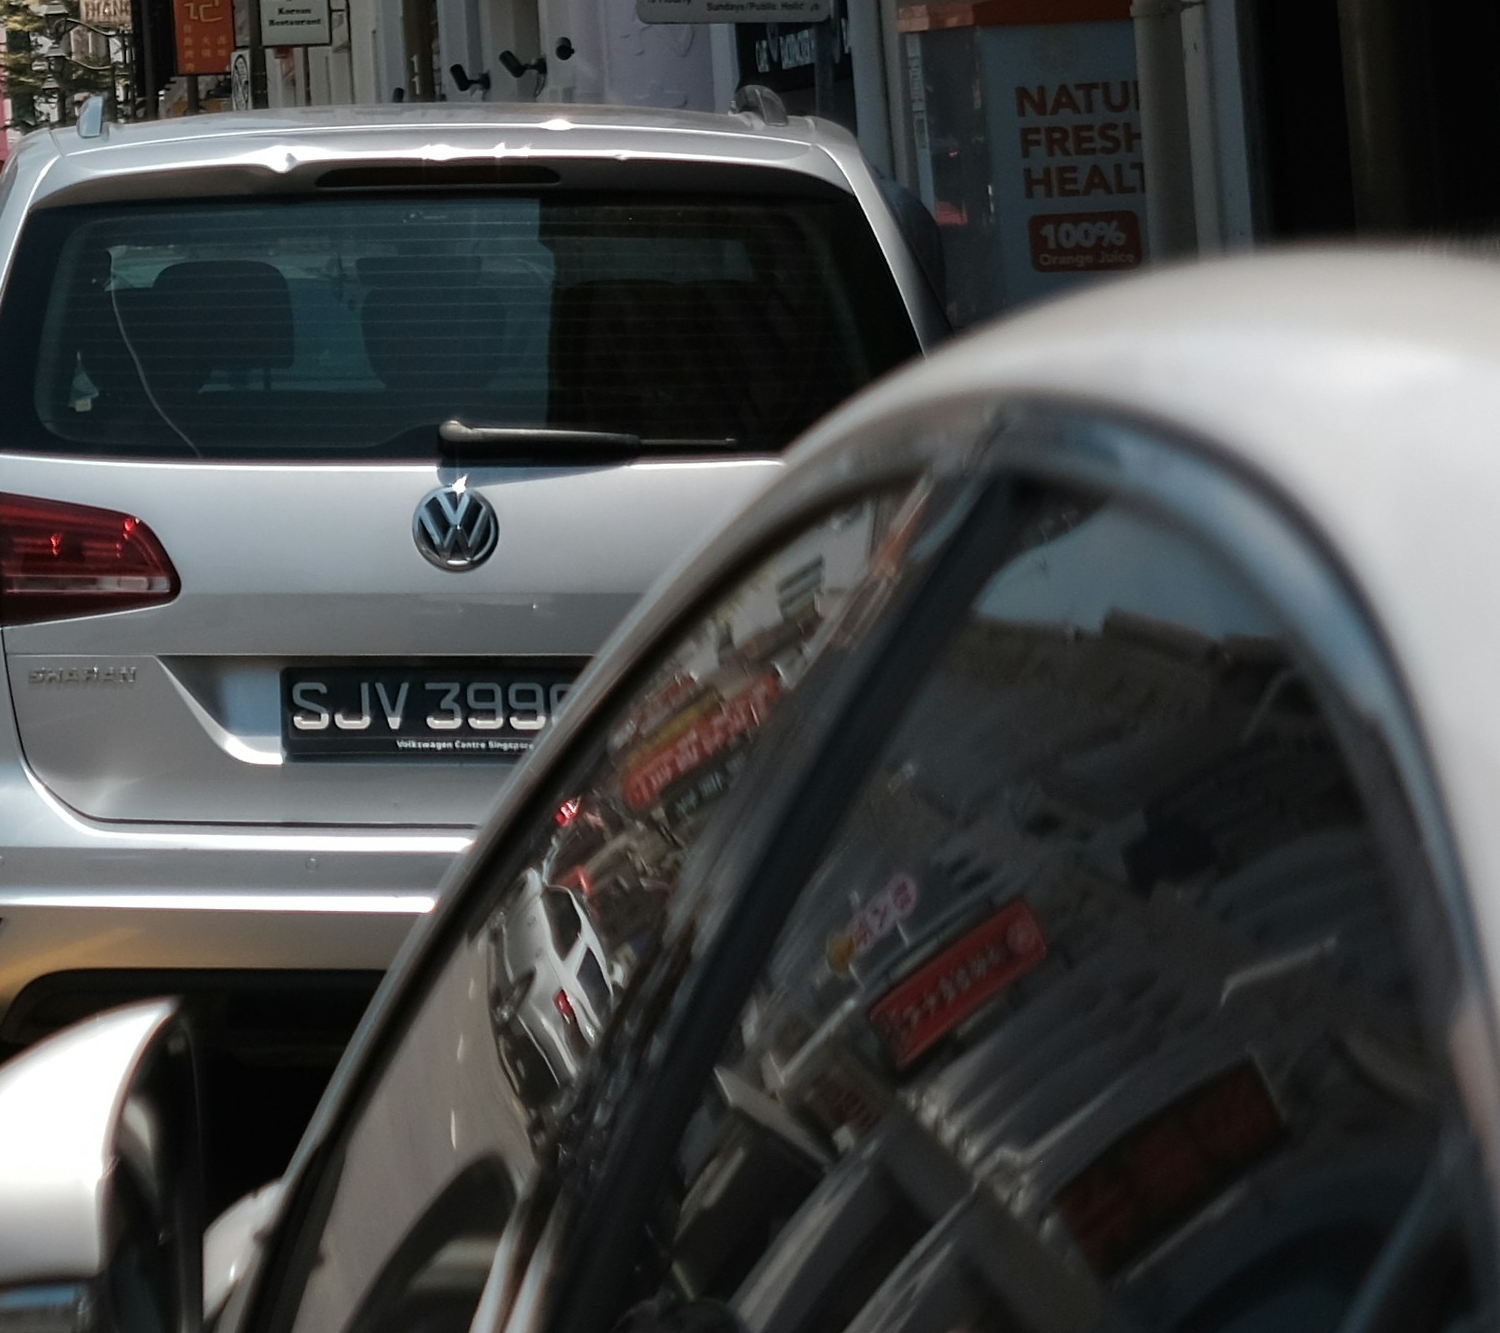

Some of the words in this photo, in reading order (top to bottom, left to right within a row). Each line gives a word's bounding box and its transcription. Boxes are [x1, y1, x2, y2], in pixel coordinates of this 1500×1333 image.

[277, 6, 312, 16] Korean
[268, 17, 322, 27] Restaurant
[1039, 221, 1126, 251] 100%
[1040, 254, 1094, 268] Orange
[1100, 251, 1135, 264] Juice
[28, 667, 138, 683] SHARAN
[292, 680, 408, 731] SJV
[396, 737, 453, 751] Volkswagen
[454, 738, 487, 749] Centre
